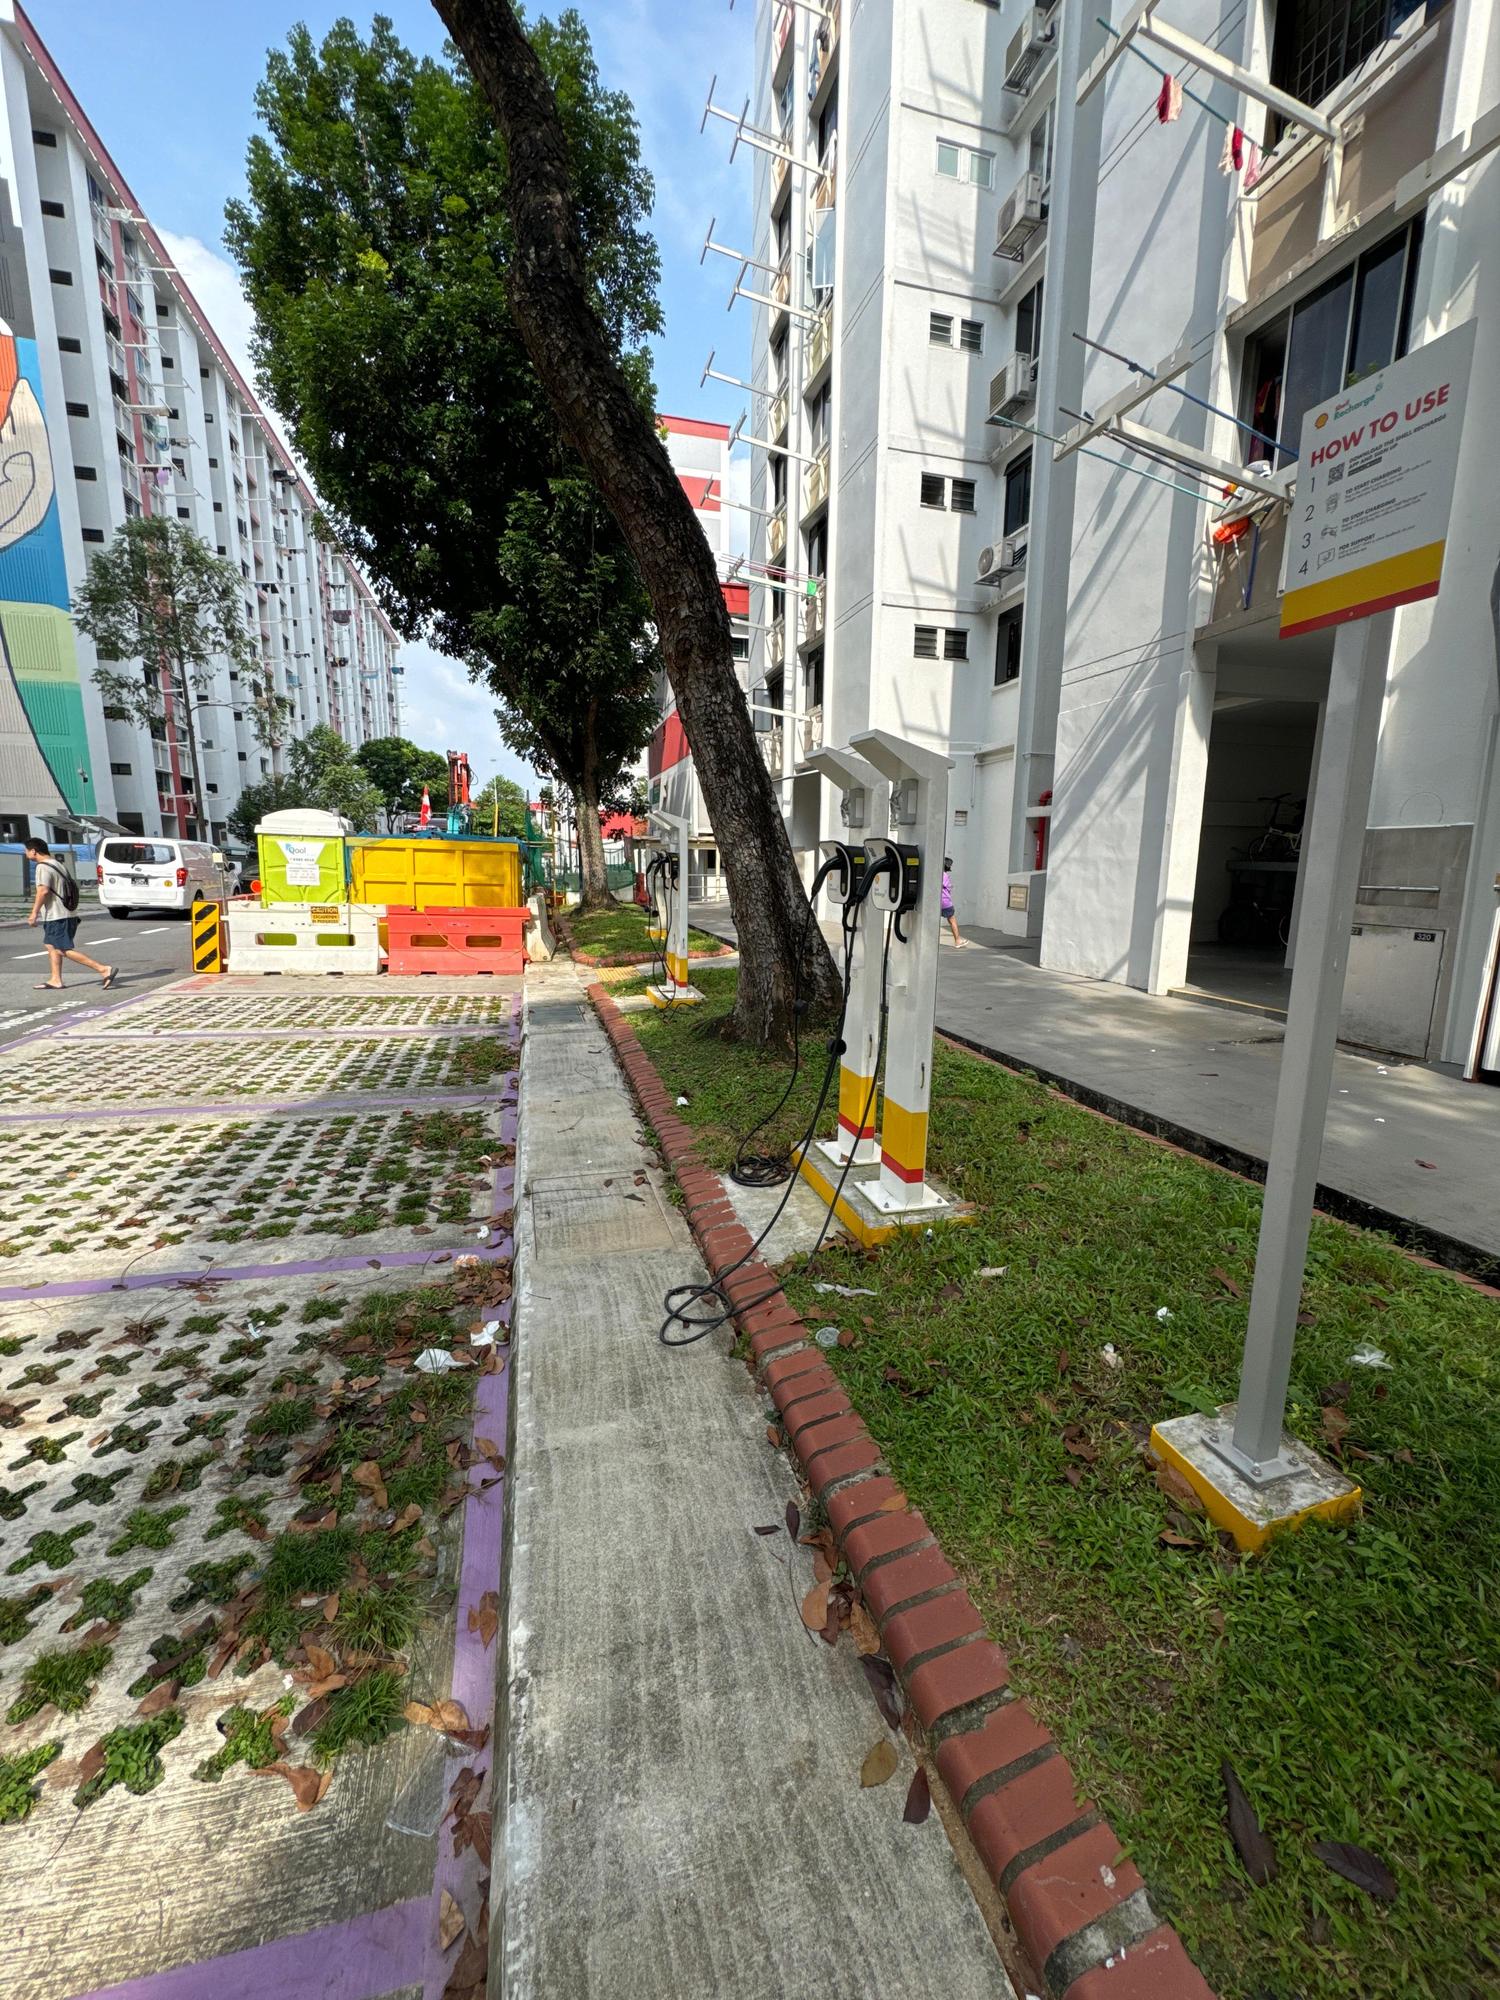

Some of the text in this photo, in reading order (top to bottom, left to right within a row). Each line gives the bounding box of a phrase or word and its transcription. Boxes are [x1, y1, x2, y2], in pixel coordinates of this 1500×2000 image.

[1334, 394, 1376, 420] Recharge
[1310, 426, 1365, 468] HOW
[1369, 411, 1399, 439] TO
[1405, 383, 1450, 422] USE
[1396, 430, 1412, 442] SHELL
[1310, 477, 1315, 492] 1
[1304, 504, 1314, 523] 2
[1302, 532, 1311, 549] 3
[1298, 560, 1308, 575] 4
